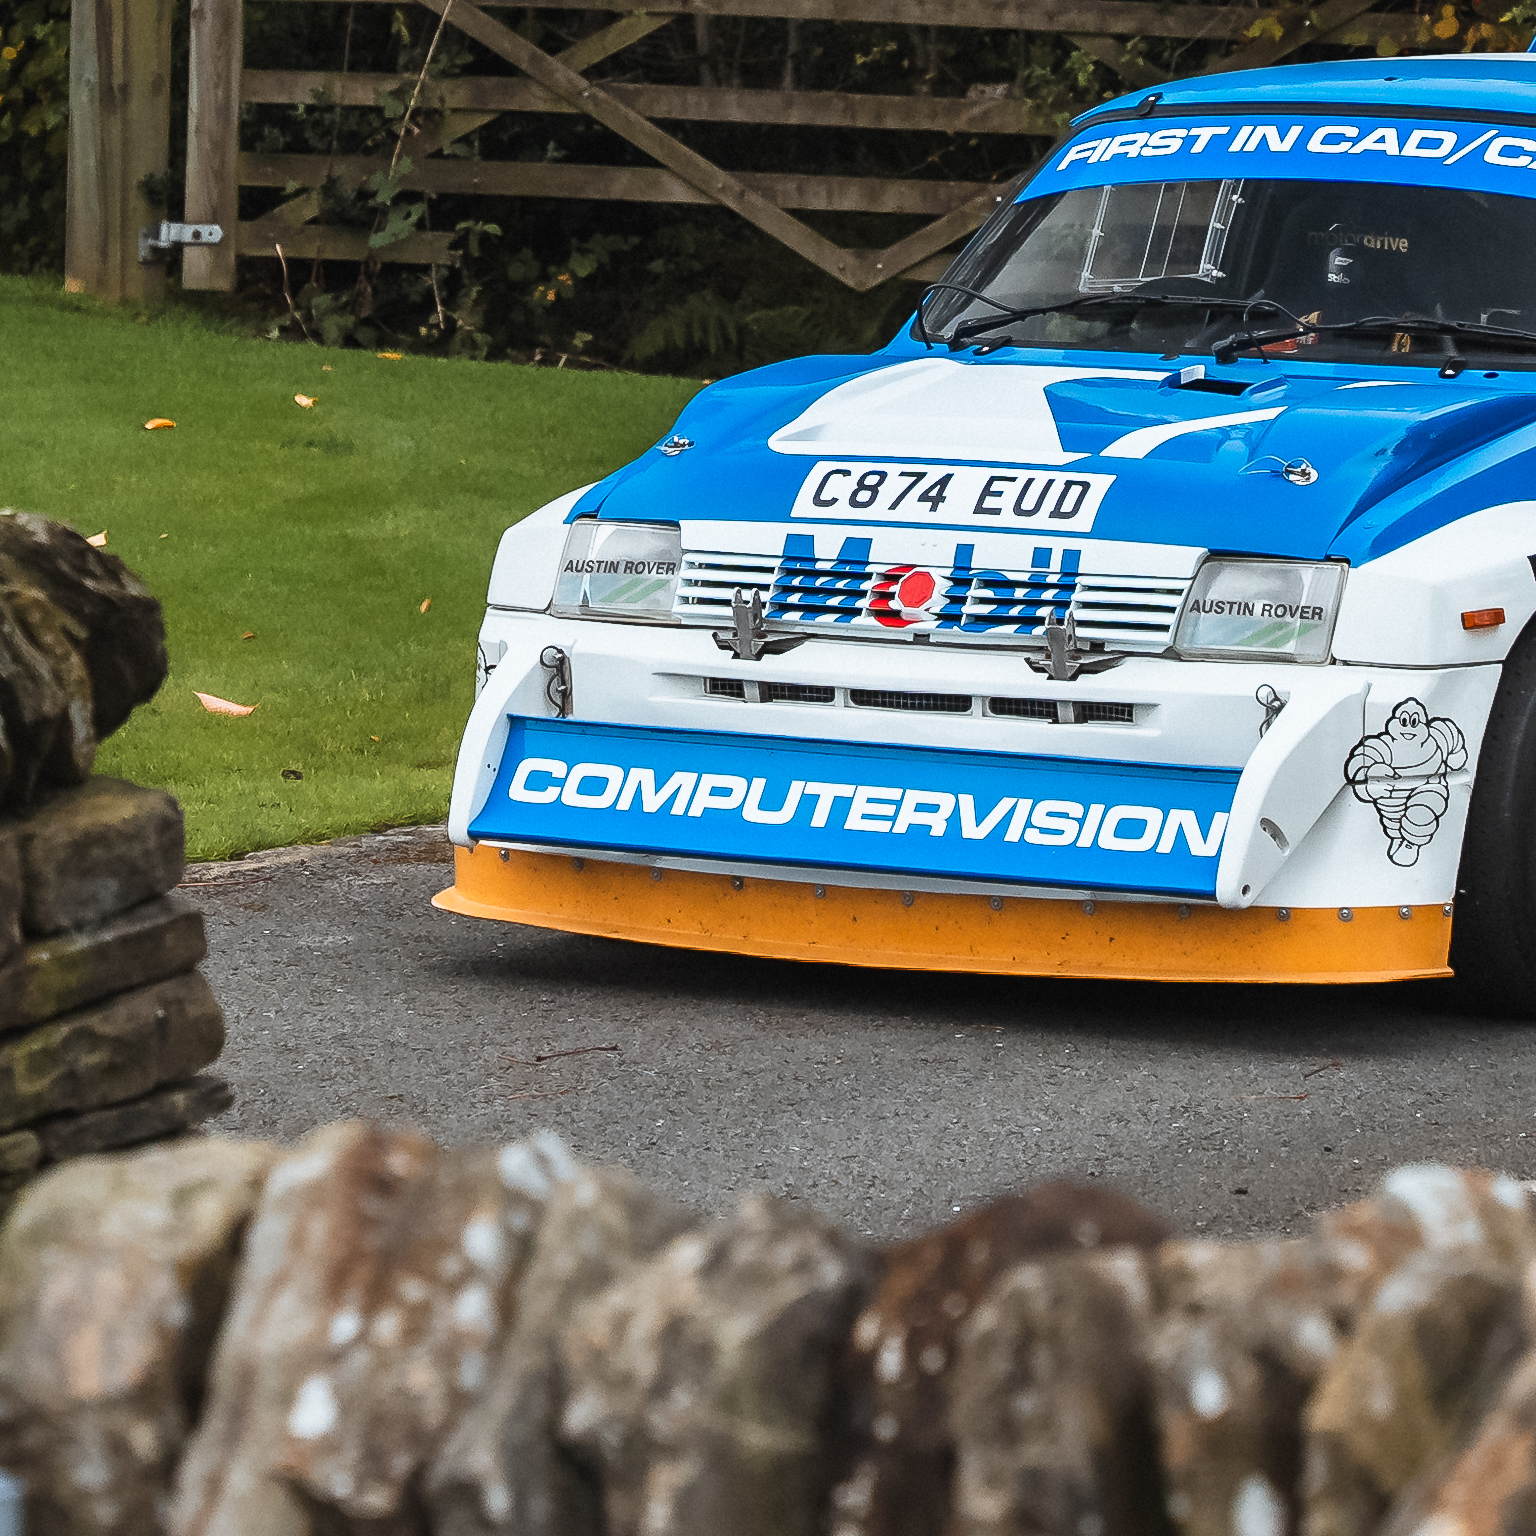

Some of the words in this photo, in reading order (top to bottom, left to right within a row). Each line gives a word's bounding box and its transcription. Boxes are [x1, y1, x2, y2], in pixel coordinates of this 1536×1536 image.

[1055, 124, 1231, 172] FIRST
[1227, 124, 1299, 154] IN
[811, 469, 950, 513] C874
[972, 477, 1092, 520] EUD
[564, 559, 620, 574] AUSTIN
[623, 560, 677, 576] ROVER
[1189, 599, 1255, 617] AUSTIN
[1261, 603, 1324, 621] ROVER
[508, 756, 1228, 858] COMPUTERVISION
